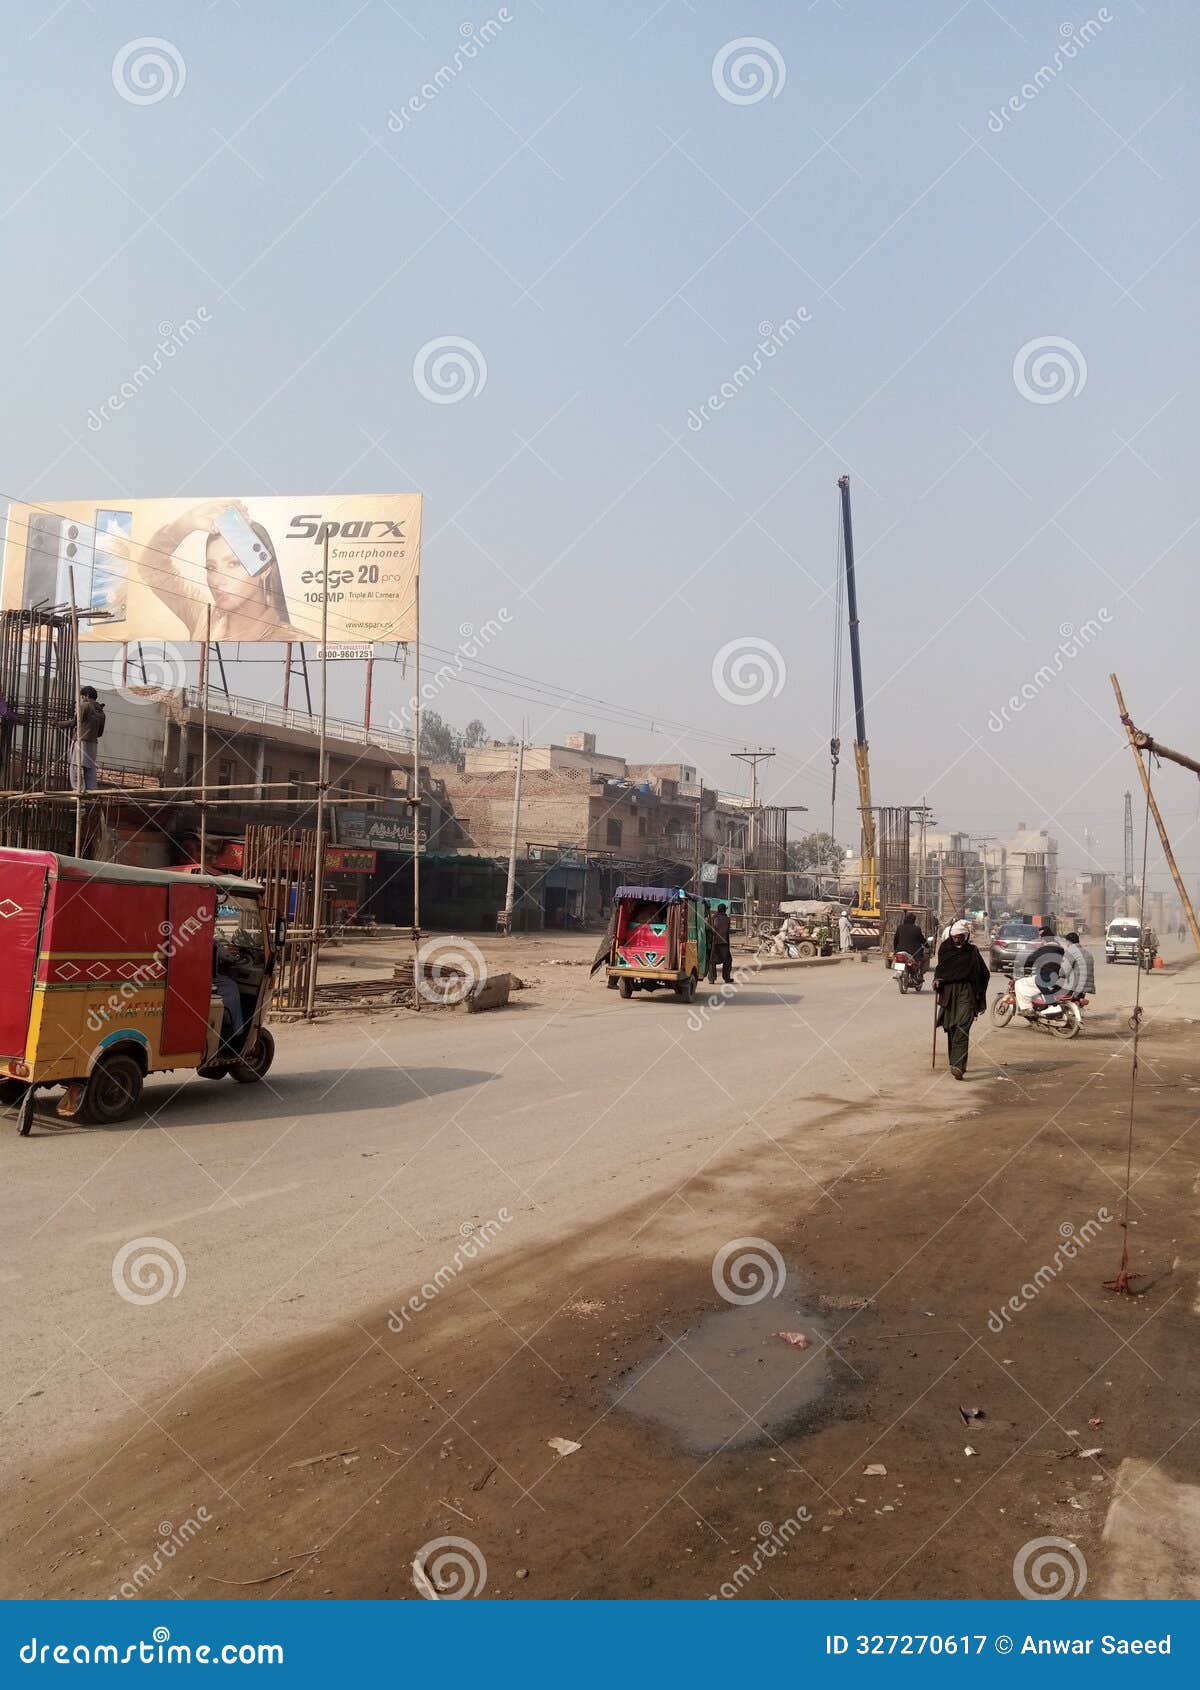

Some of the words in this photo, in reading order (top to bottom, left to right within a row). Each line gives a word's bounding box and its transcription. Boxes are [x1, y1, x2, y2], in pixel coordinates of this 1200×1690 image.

[285, 514, 406, 545] Sparx
[331, 548, 405, 559] Smartphones
[358, 565, 379, 584] 20
[381, 574, 401, 584] pro
[349, 591, 366, 600] Triple
[318, 650, 374, 659] 000-9601251
